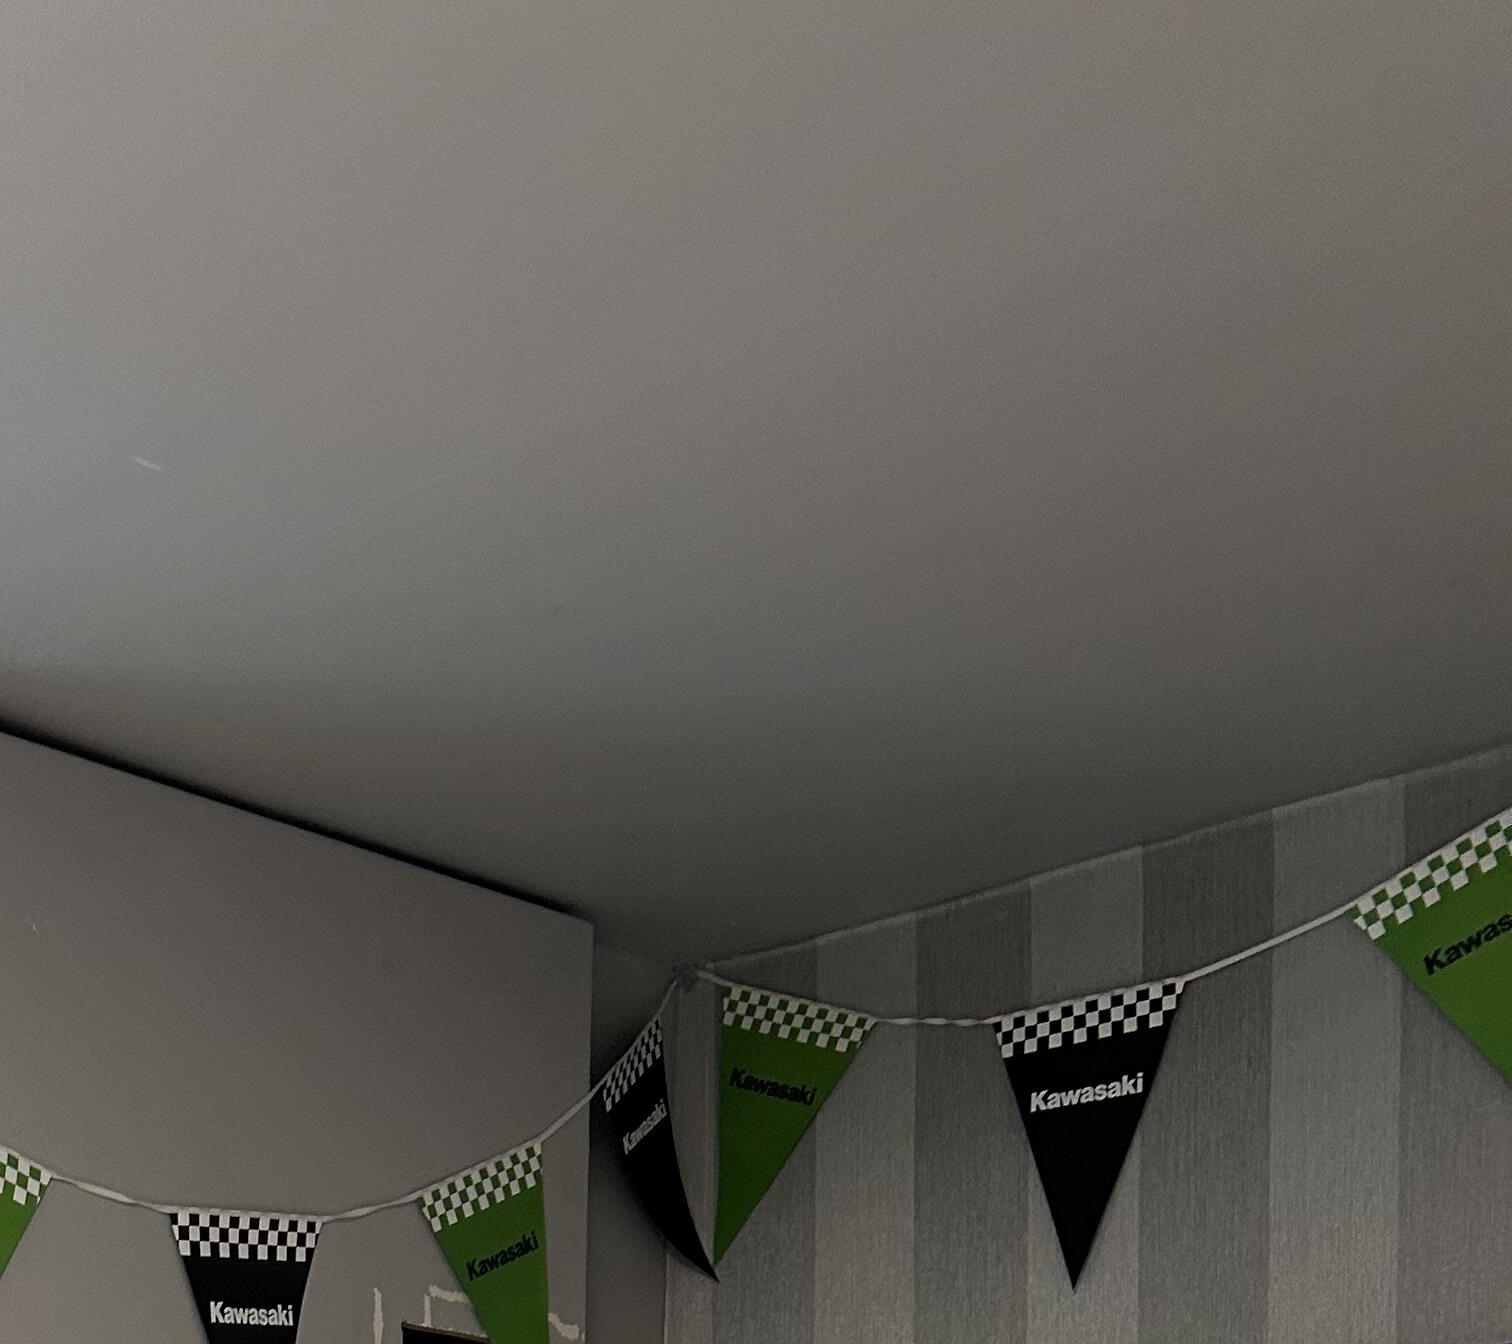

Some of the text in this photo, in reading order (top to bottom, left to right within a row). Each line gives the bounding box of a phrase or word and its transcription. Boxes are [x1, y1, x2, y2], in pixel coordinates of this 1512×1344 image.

[728, 1066, 818, 1106] Kawasaki
[1029, 1072, 1145, 1113] Kawasaki
[622, 1097, 668, 1155] Kawasaki
[465, 1230, 540, 1282] Kawasaki
[209, 1300, 294, 1327] Kawasaki
